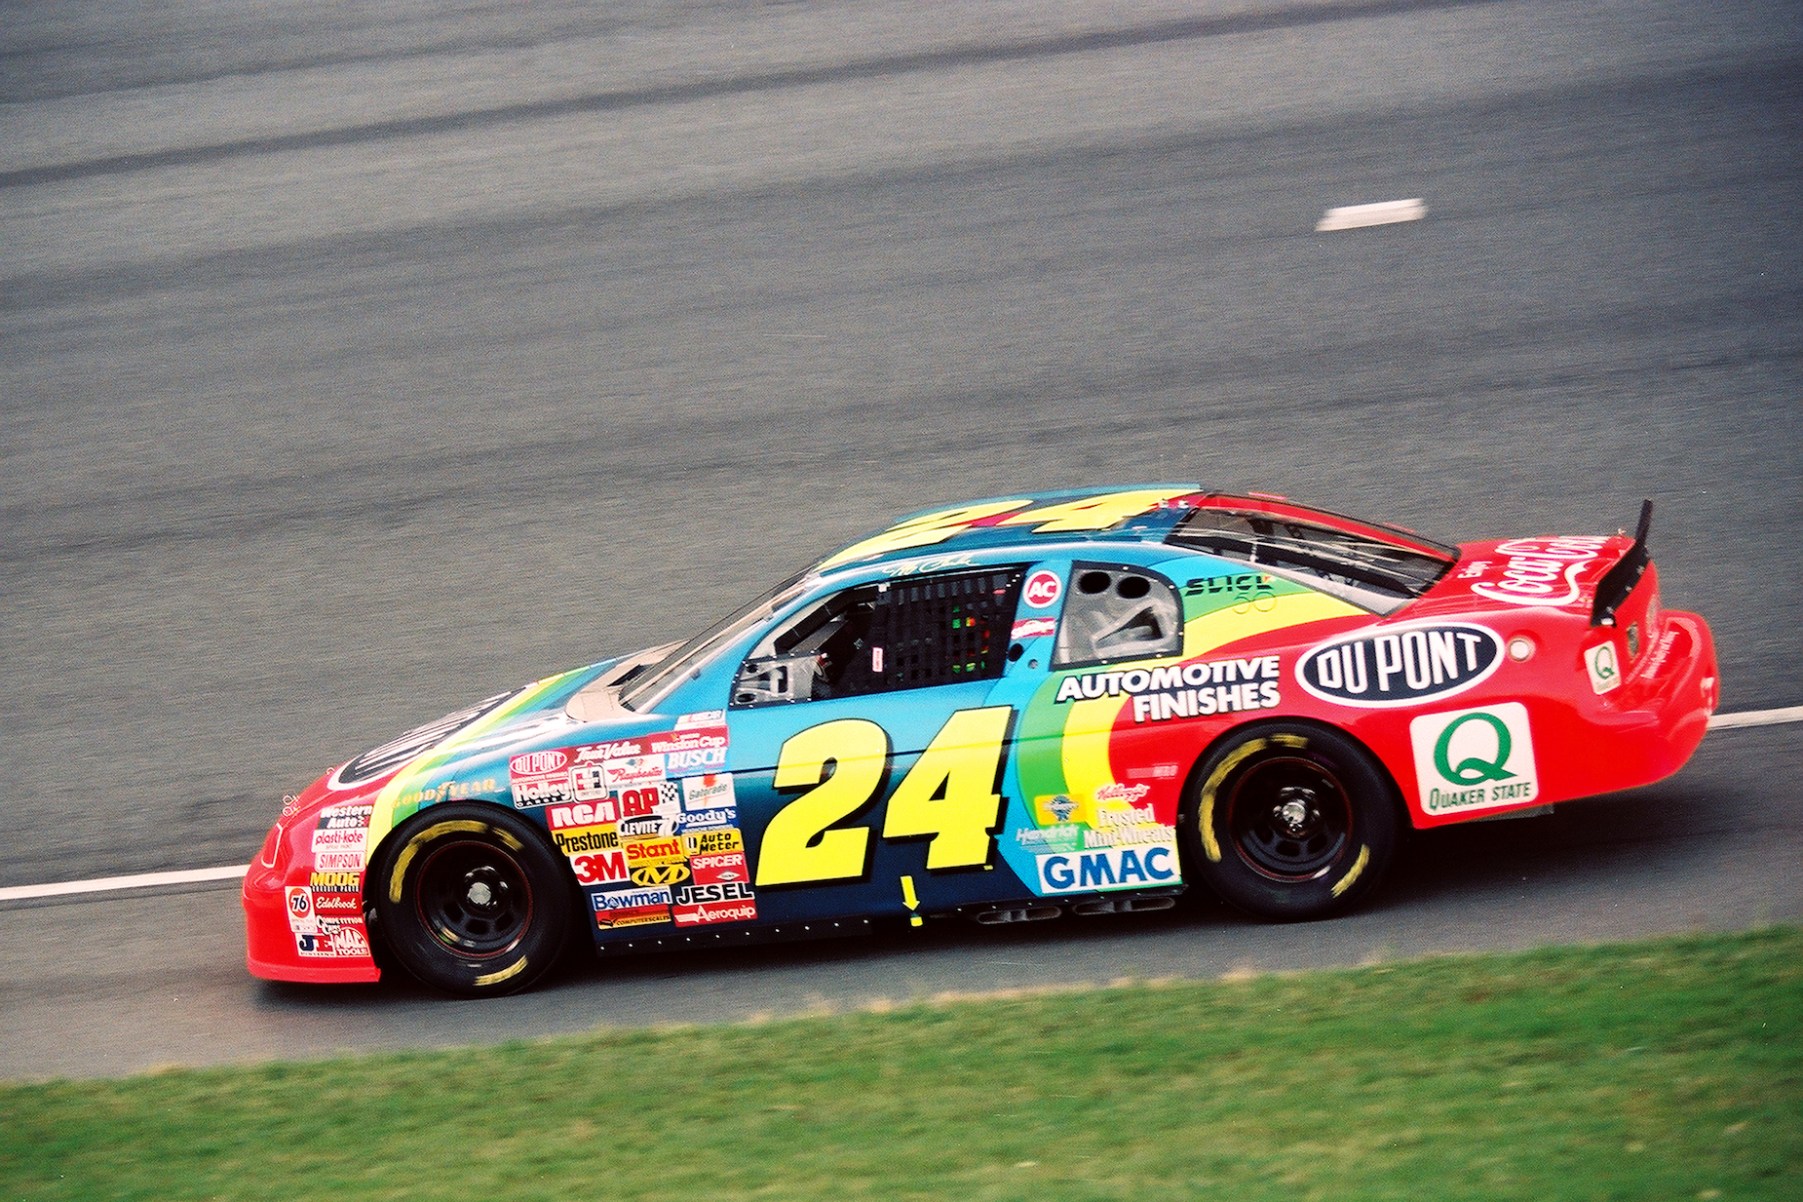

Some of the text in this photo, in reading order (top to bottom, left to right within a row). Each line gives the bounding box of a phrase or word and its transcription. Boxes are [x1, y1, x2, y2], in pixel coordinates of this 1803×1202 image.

[1027, 580, 1057, 598] AC
[1374, 630, 1483, 693] PONT
[1055, 656, 1281, 702] AUTOMOTIVE
[1132, 679, 1281, 723] FINISHES
[699, 736, 726, 749] Cup
[667, 747, 728, 770] BUSCH
[514, 783, 571, 802] Holley
[755, 704, 1014, 887] 24
[1492, 782, 1531, 801] STATE
[622, 787, 660, 817] AP
[320, 806, 373, 818] Western
[551, 801, 617, 828] RCA
[677, 808, 737, 825] Goody's
[327, 817, 358, 829] Auto
[316, 829, 363, 845] plasti-kote
[555, 832, 619, 853] Prestone
[701, 832, 731, 843] Auto
[701, 841, 739, 852] Meter
[626, 839, 680, 860] Stant
[320, 854, 361, 868] SIMPSON
[575, 852, 627, 884] 3M
[693, 854, 743, 870] SPICER
[1043, 847, 1174, 889] GMAC
[310, 872, 360, 887] MOOG
[291, 894, 308, 912] 76
[593, 891, 670, 911] Bowman
[677, 883, 754, 905] JESEL
[696, 905, 756, 922] Aeroquip
